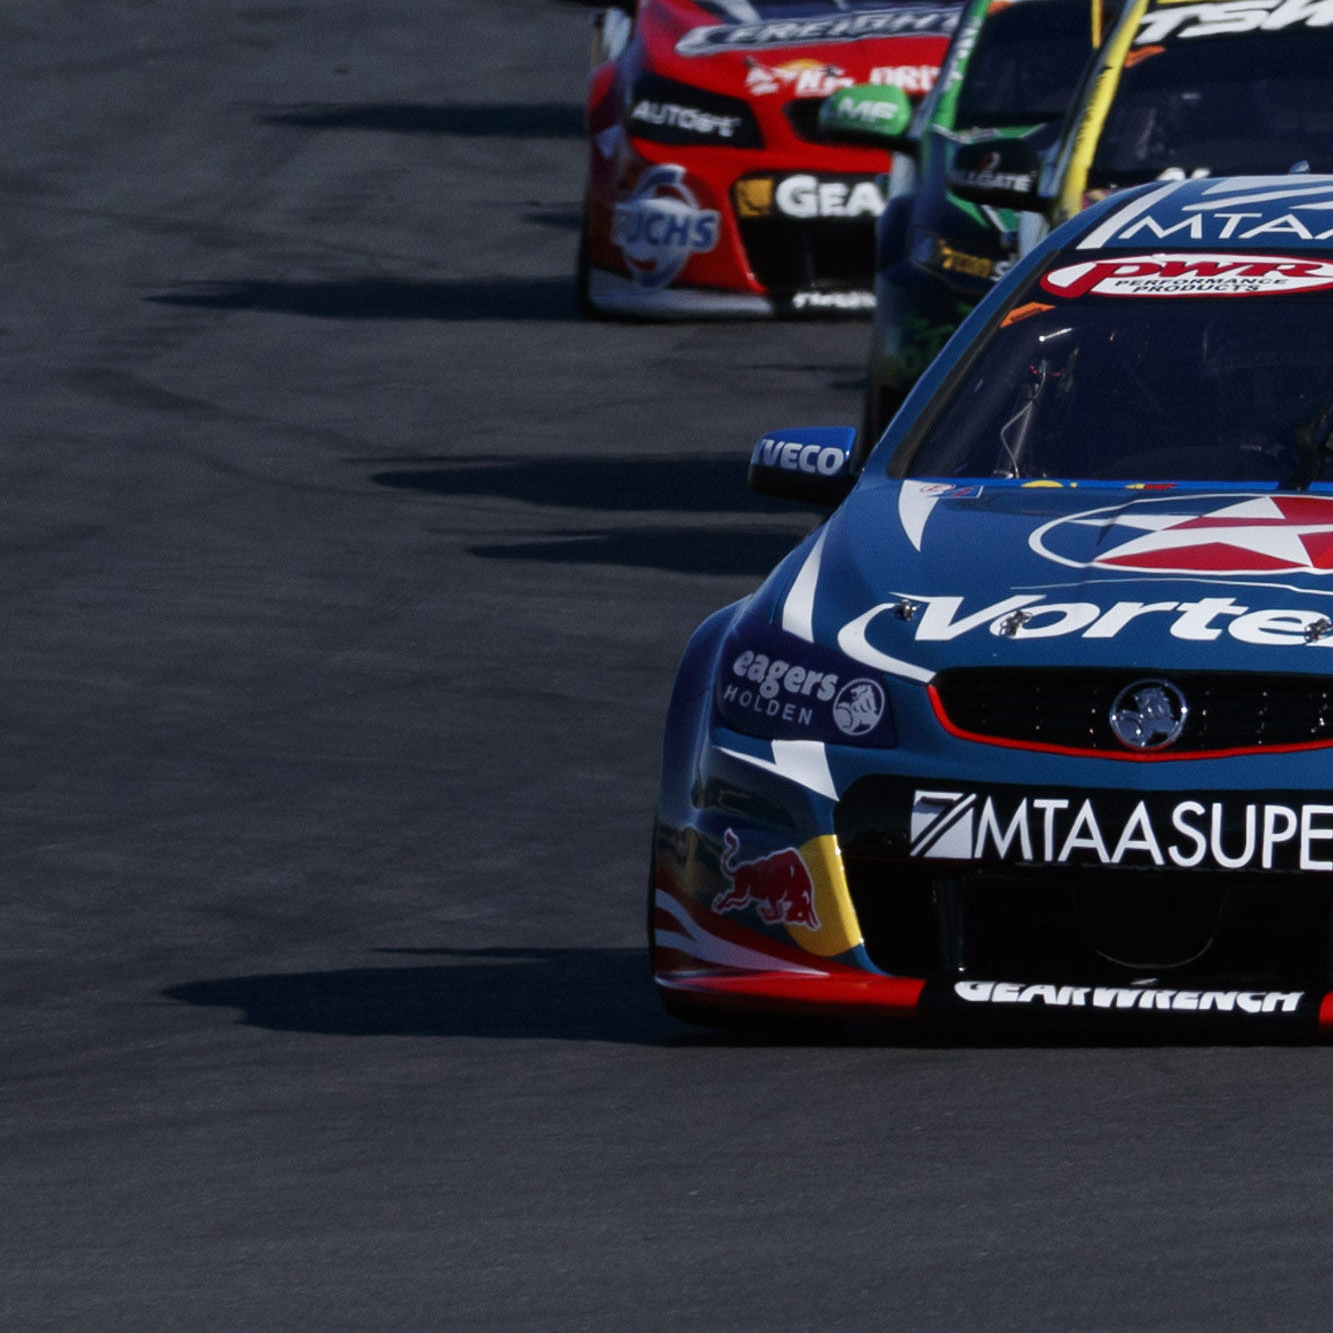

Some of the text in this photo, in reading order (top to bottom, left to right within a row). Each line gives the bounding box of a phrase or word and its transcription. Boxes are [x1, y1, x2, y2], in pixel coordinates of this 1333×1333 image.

[1115, 277, 1290, 287] PERFORMANCE
[1131, 284, 1261, 294] PRODUCTS
[752, 439, 845, 476] IVECO
[731, 647, 840, 703] eagers
[722, 683, 813, 726] HOLDEN
[953, 980, 1304, 1014] GEARWRENCH
